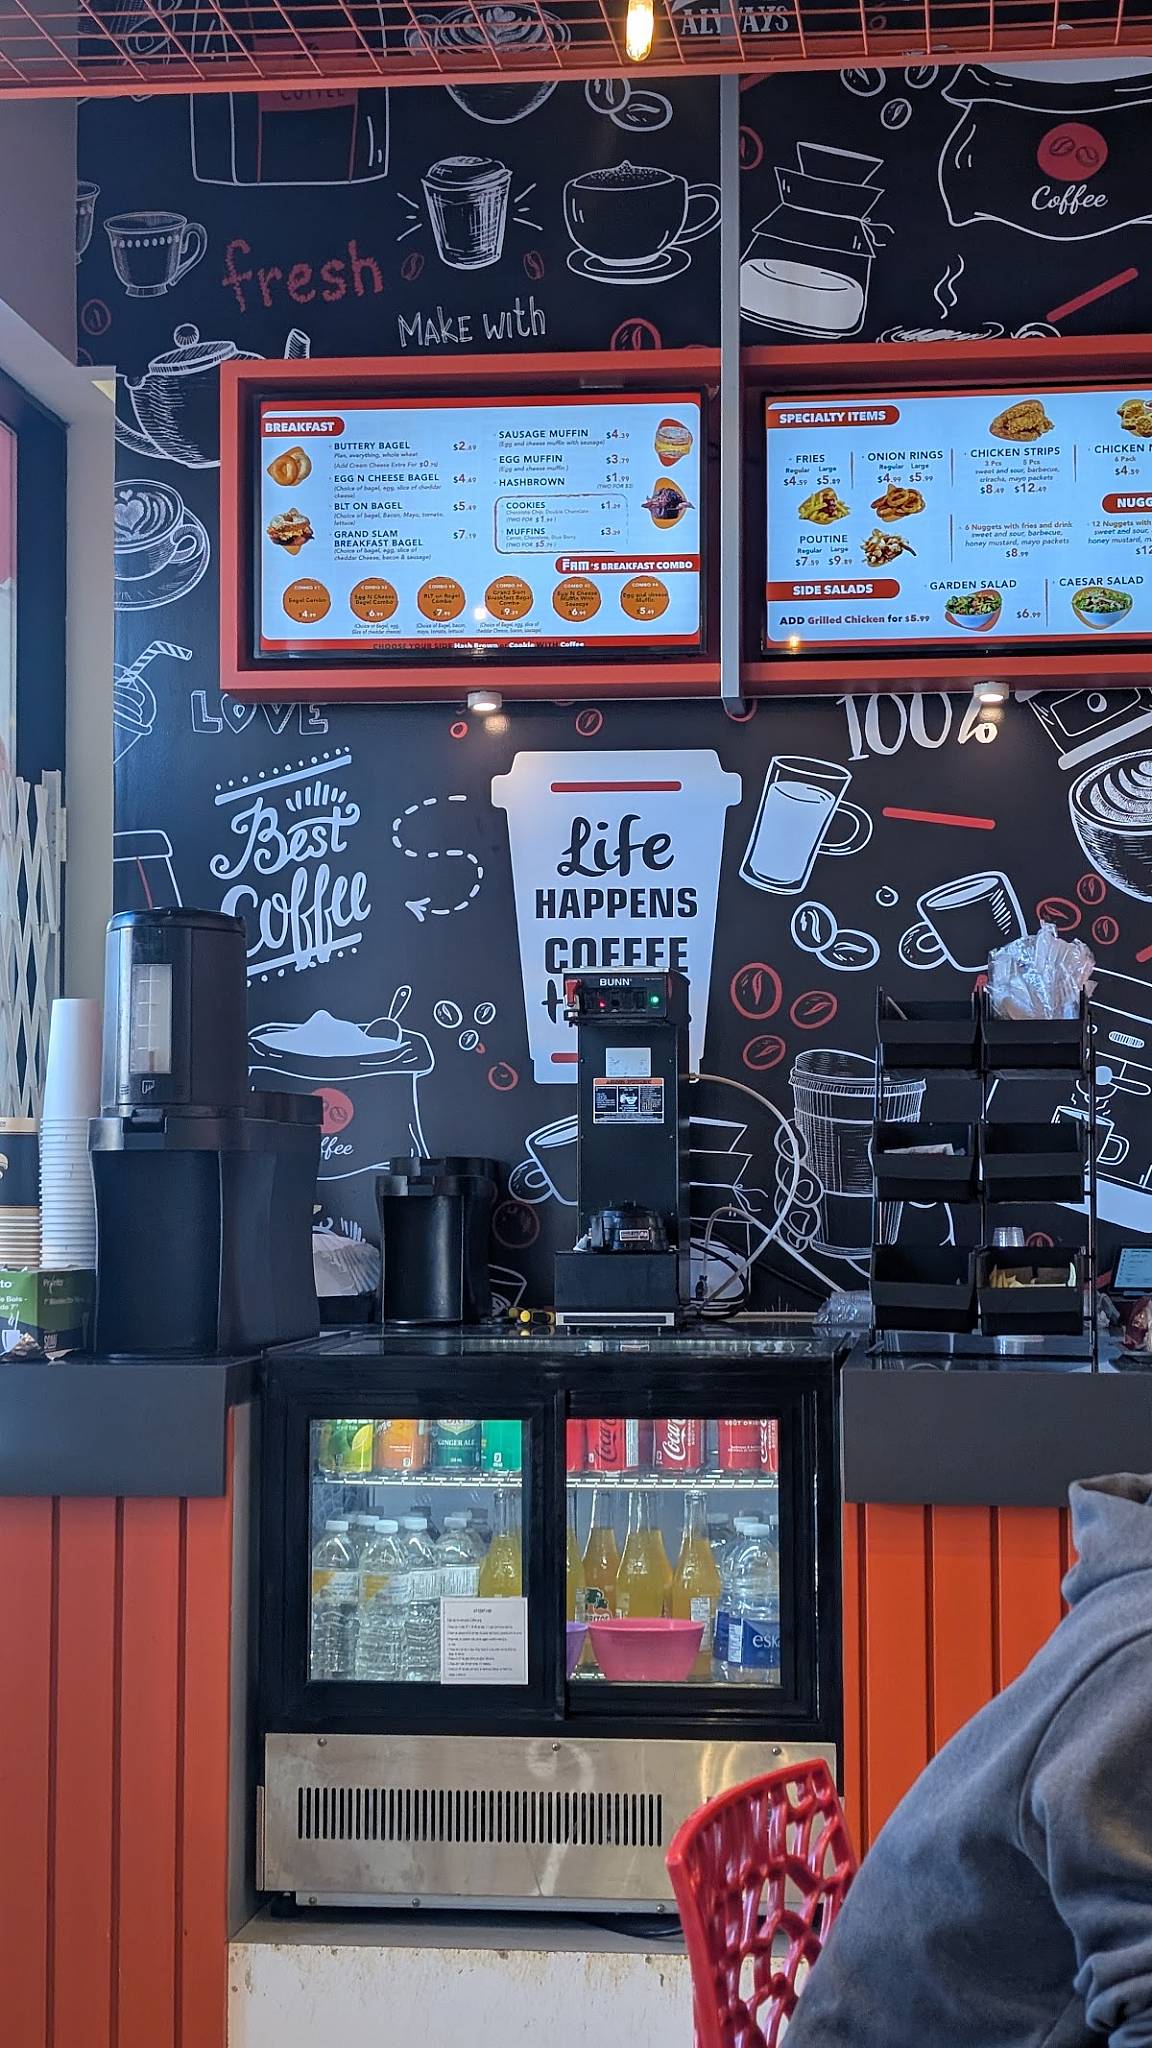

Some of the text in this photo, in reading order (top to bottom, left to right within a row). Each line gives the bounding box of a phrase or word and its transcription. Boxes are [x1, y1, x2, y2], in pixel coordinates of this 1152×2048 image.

[681, 4, 789, 36] ALAYS
[1031, 185, 1109, 216] Coffee
[222, 239, 384, 312] fresh
[397, 296, 547, 348] MAKE with
[779, 411, 886, 424] SPECIALTY ITEMS
[265, 422, 335, 433] BREAKFAST
[499, 429, 588, 438] SAUSAGE MUFFIN
[334, 442, 375, 450] BUTTERY
[1094, 444, 1145, 454] CHICKEN
[868, 451, 943, 461] ONION RINGS
[970, 447, 1060, 458] CHICKEN STRIPS
[499, 455, 562, 463] EGG MUFFIN
[796, 455, 825, 463] FRIES
[786, 466, 836, 475] Regular Large
[879, 463, 929, 472] Regular Large
[334, 475, 354, 483] EGG
[368, 474, 404, 482] CHEESE
[499, 478, 565, 486] HASHBROWN
[353, 502, 367, 510] ON
[371, 502, 403, 510] BAGEL
[971, 524, 1002, 532] Nuggets
[1103, 520, 1134, 528] Nuggets
[372, 530, 398, 538] SLAM
[800, 535, 848, 543] POUTINE
[392, 539, 423, 547] BAGEL
[830, 546, 849, 554] Large
[601, 562, 655, 570] BREAKFAST
[656, 561, 693, 569] COMBO
[930, 580, 1017, 590] GARDEN SALAD
[1059, 576, 1144, 587] CAESAR SALAD
[793, 584, 873, 595] SIDE SALADS
[780, 614, 930, 625] ADD Grilled Chicken for $5.99
[209, 797, 360, 880] Best
[556, 813, 675, 878] Life
[535, 888, 698, 919] HAPPENS
[544, 936, 689, 974] COFFEE
[600, 978, 630, 986] BUNN
[320, 1137, 354, 1160] ffee
